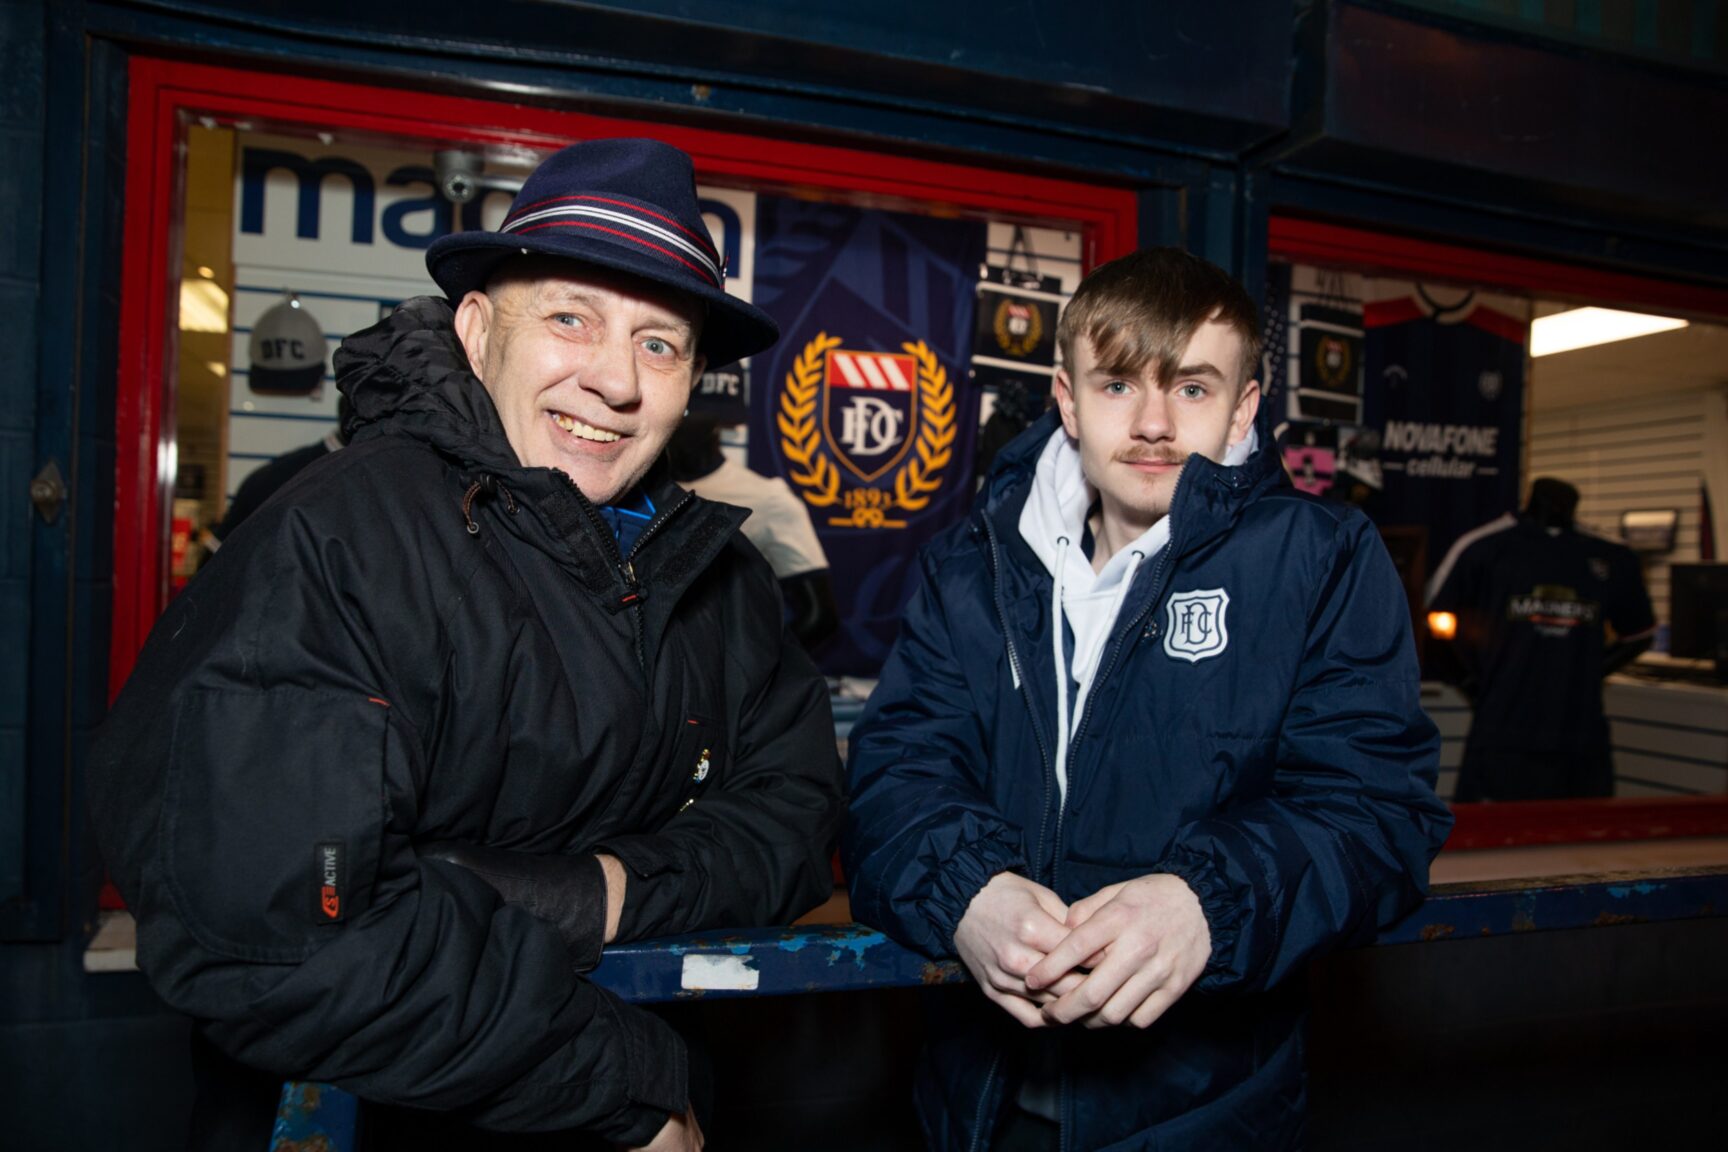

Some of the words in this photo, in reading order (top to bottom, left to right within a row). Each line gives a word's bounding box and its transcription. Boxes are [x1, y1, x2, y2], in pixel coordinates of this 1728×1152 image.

[1382, 420, 1500, 457] NOVAFONE
[1405, 456, 1477, 479] cellular
[323, 846, 338, 887] ACTIVE
